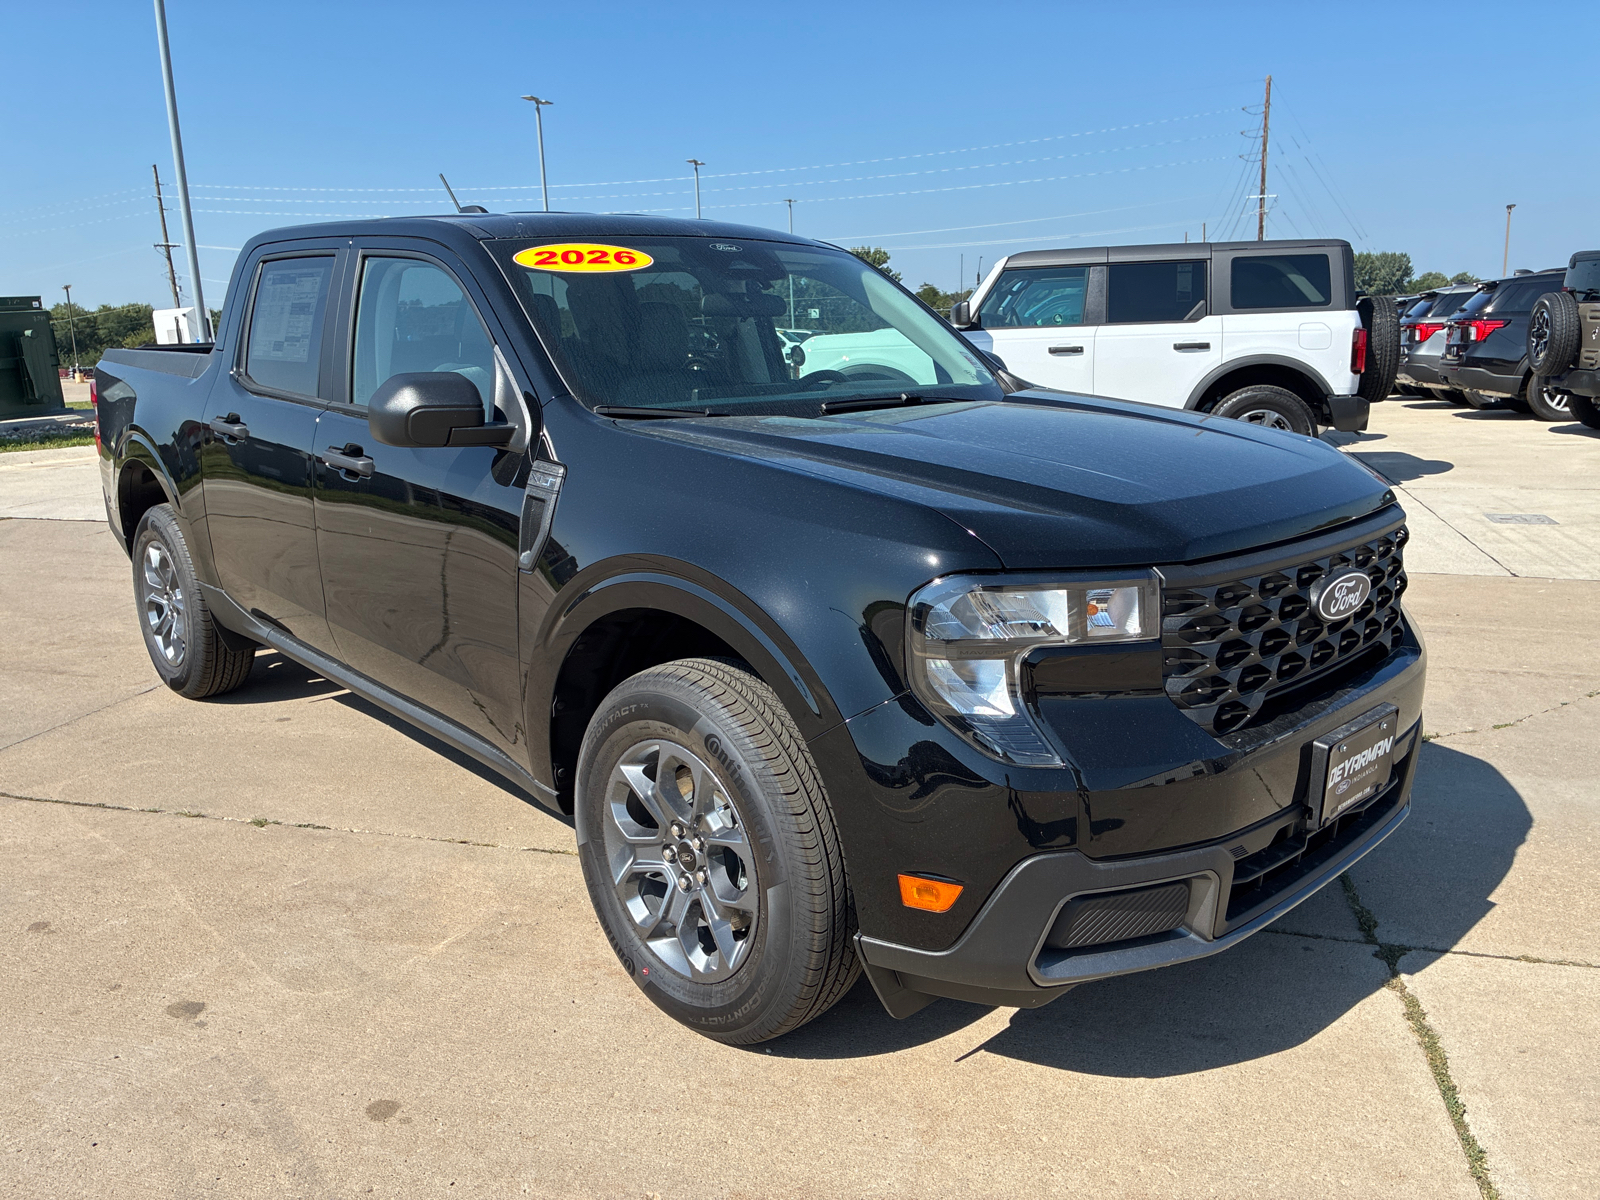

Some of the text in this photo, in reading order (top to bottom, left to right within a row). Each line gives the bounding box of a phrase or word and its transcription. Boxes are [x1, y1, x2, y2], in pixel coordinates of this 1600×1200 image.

[533, 249, 637, 265] 2026
[1330, 579, 1362, 613] Ford
[1328, 736, 1393, 789] DEYARMAN
[1351, 763, 1379, 784] INDIANOLA
[704, 733, 772, 844] Continental
